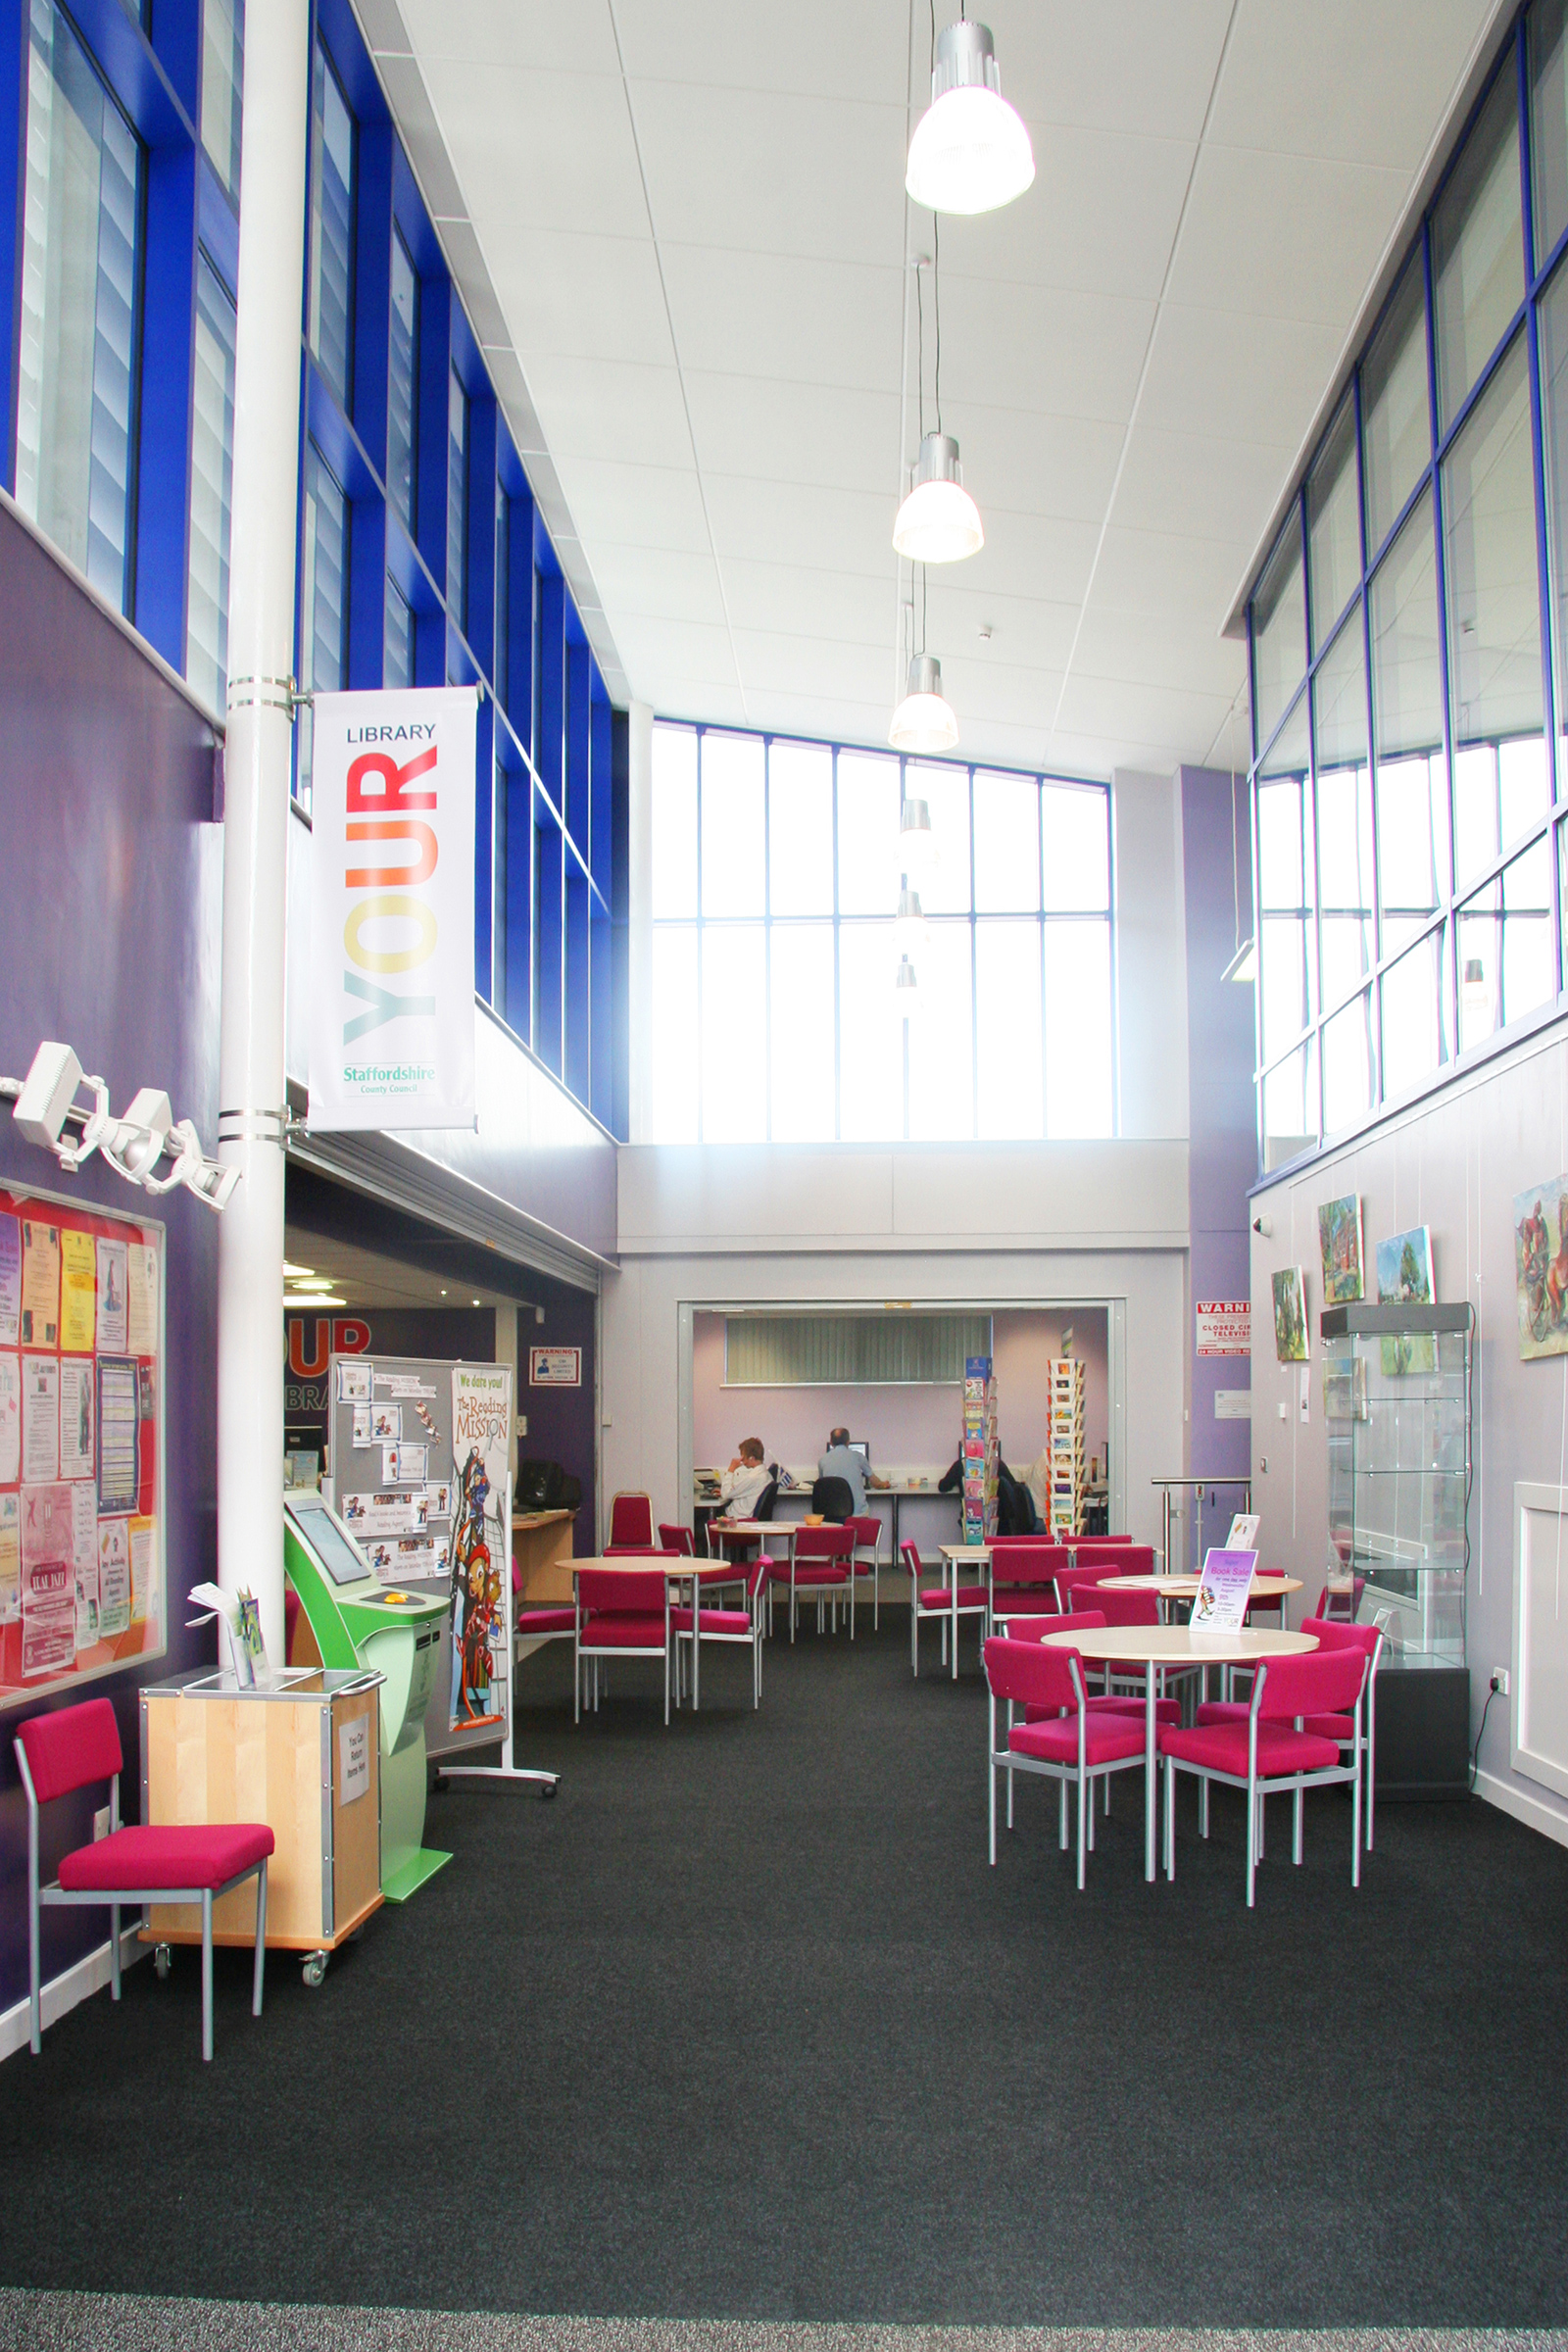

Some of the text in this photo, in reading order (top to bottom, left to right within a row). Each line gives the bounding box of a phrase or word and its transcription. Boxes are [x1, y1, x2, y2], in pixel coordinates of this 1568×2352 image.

[347, 723, 436, 744] LIBRARY
[343, 744, 438, 1047] YOUR
[343, 1065, 436, 1082] Staffordshire
[360, 1084, 417, 1095] County Council
[1200, 1303, 1250, 1313] WARNI
[283, 1318, 371, 1378] UR
[460, 1374, 503, 1391] We dare you!
[457, 1396, 508, 1419] The Reading
[455, 1412, 508, 1445] MISSION
